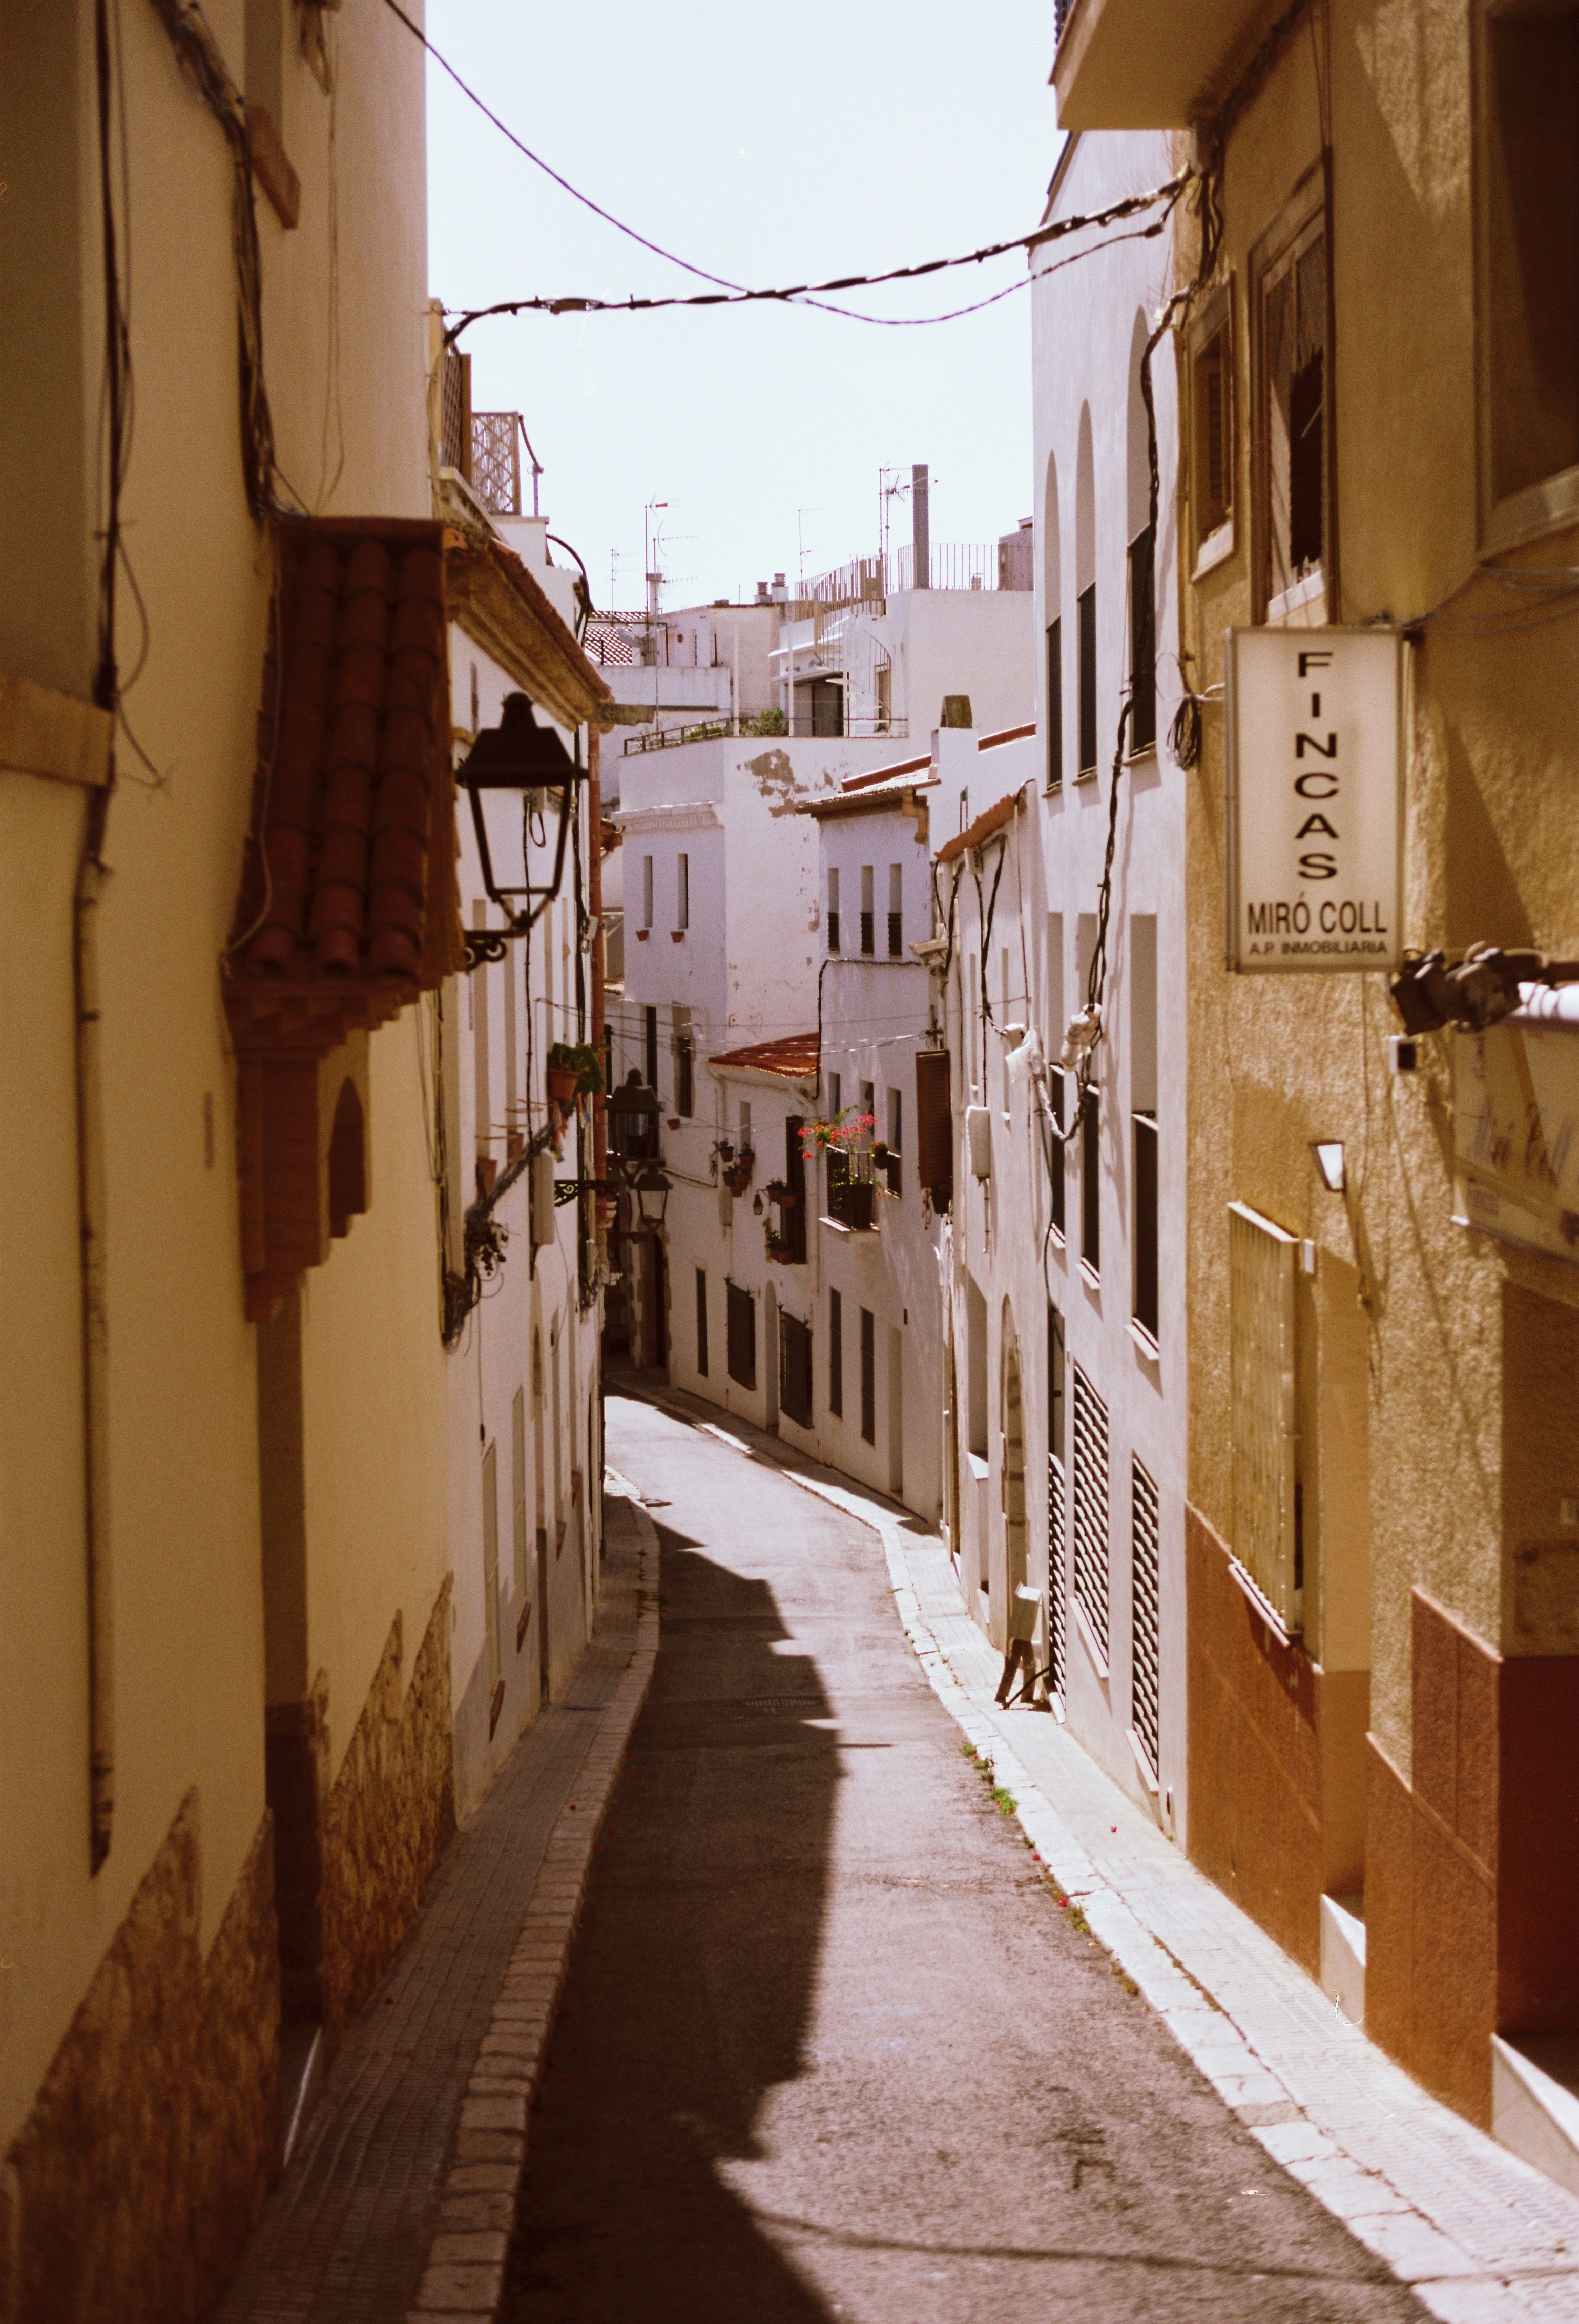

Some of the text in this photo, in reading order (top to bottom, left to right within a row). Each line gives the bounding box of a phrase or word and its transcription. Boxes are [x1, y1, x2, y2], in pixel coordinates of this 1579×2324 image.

[1294, 651, 1339, 880] FINCAS
[1248, 891, 1388, 935] MIRÓ COLL
[1281, 940, 1388, 955] INMOBILIARIA
